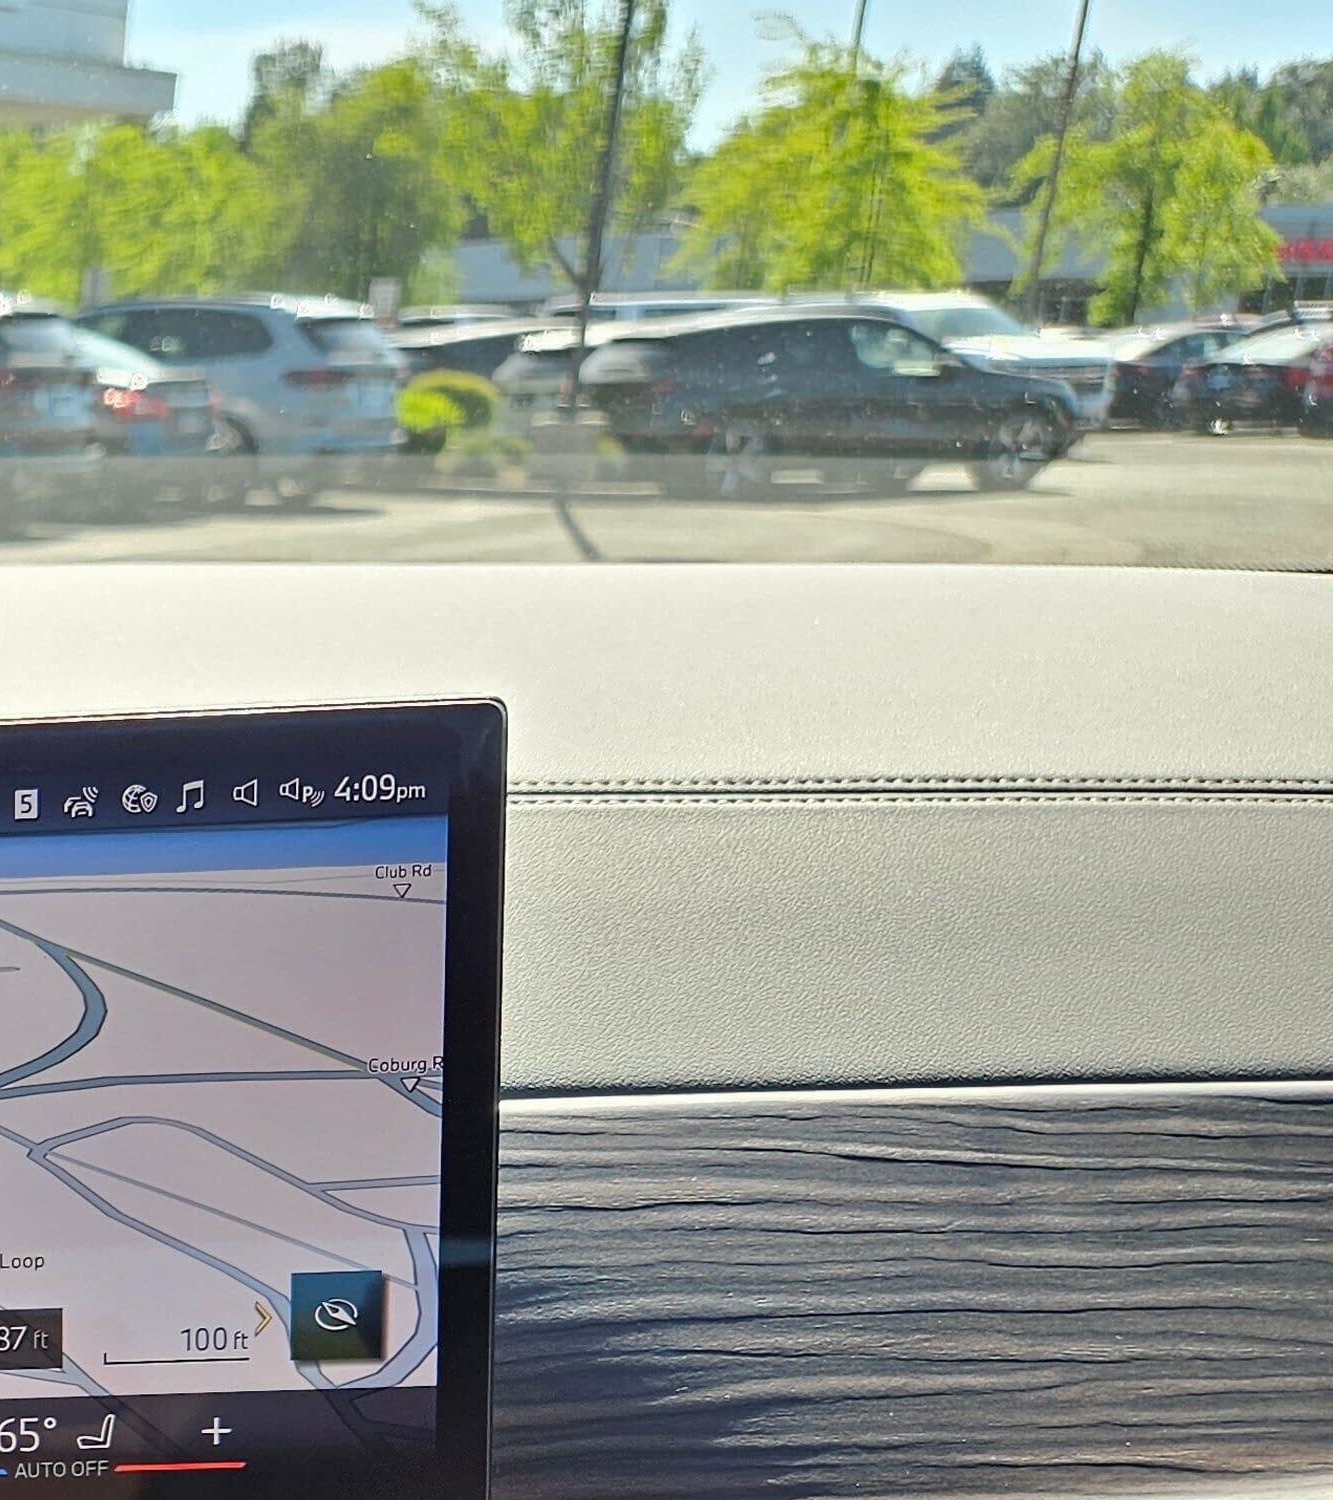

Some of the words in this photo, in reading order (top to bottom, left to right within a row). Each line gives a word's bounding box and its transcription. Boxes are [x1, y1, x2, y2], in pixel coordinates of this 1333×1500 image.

[334, 774, 427, 802] 4:09pm
[20, 792, 33, 813] 5
[375, 865, 407, 879] Club
[412, 863, 432, 877] Rd
[369, 1058, 427, 1074] Coburg
[32, 1328, 48, 1351] ft
[181, 1327, 228, 1352] 100
[233, 1329, 249, 1351] ft
[14, 1461, 66, 1479] AUTO
[71, 1460, 109, 1477] OFF
